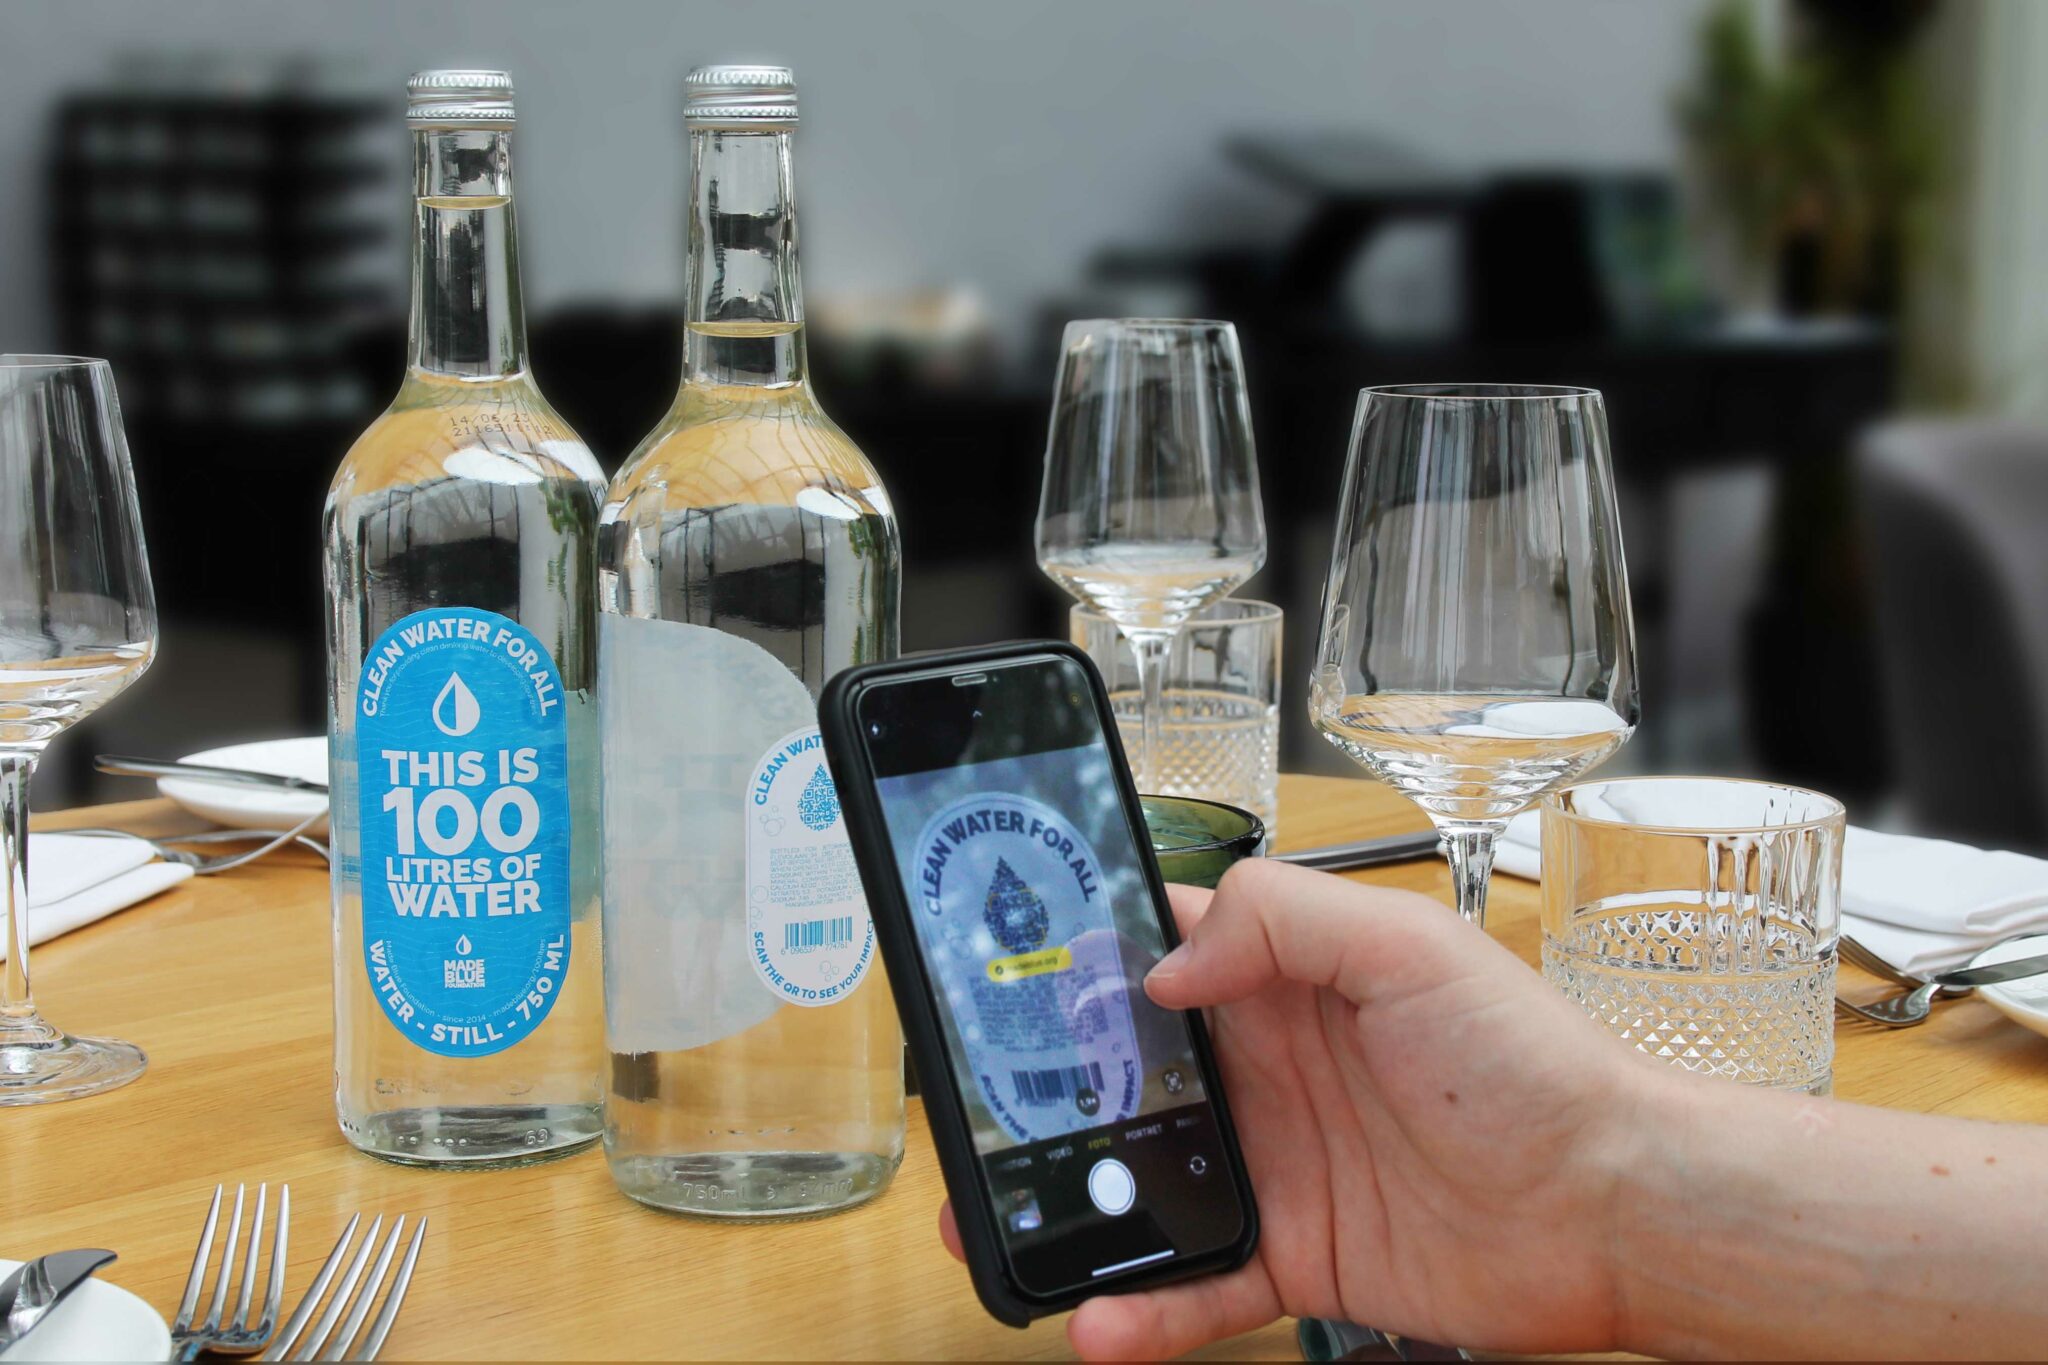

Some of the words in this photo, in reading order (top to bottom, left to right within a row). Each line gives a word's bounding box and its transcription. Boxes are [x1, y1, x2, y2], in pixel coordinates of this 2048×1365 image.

[362, 640, 404, 717] CLEAN
[400, 618, 491, 648] WATER
[493, 628, 539, 672] FOR
[530, 671, 558, 717] ALL
[381, 750, 486, 786] THIS
[499, 748, 539, 784] IS
[754, 752, 788, 805] CLEAN
[786, 735, 825, 756] WAT
[383, 786, 540, 856] 100
[386, 856, 492, 883] LITRES
[500, 853, 541, 880] OF
[924, 838, 952, 916] CLEAN
[942, 809, 1025, 845] WATER
[1029, 819, 1074, 861] FOR
[1069, 856, 1097, 903] ALL
[387, 880, 542, 918] WATER
[444, 959, 485, 971] MADE
[444, 970, 485, 983] BLUE
[754, 931, 770, 964] SCAN
[765, 964, 784, 986] THE
[783, 982, 799, 996] QR
[801, 989, 816, 999] TO
[819, 985, 838, 998] SEE
[839, 963, 863, 990] YOUR
[860, 919, 874, 963] IMPACT
[370, 939, 414, 1024] WATER
[431, 1023, 503, 1045] STILL
[516, 978, 552, 1021] 750
[544, 934, 564, 971] ML
[397, 982, 436, 1016] Foundation
[441, 1014, 463, 1023] since
[466, 1013, 486, 1023] 2014
[1046, 1146, 1073, 1160] VIDEO
[1088, 1138, 1111, 1150] FOTO
[1125, 1125, 1163, 1141] PORTRET
